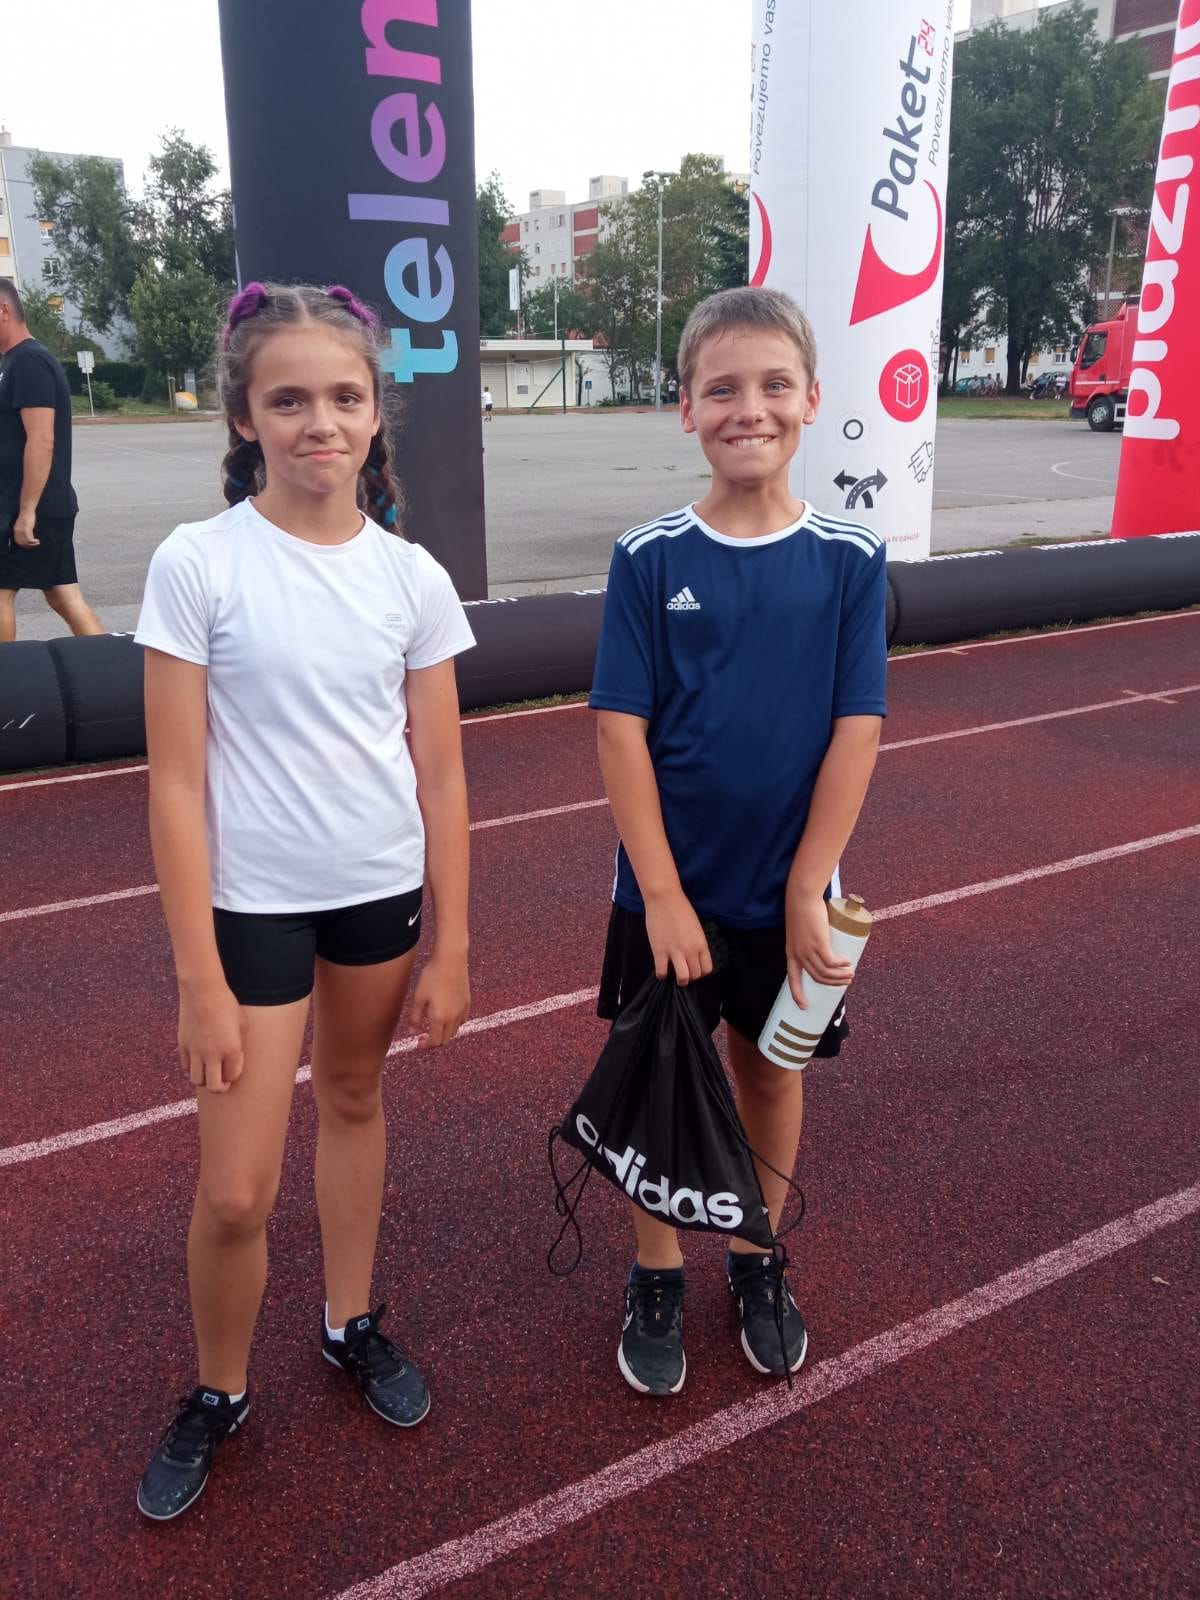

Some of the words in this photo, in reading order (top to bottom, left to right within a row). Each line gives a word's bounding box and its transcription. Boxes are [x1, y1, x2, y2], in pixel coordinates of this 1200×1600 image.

[752, 42, 772, 176] Povezujemo
[871, 34, 931, 222] Paket
[917, 18, 936, 57] 24
[928, 36, 951, 168] Povezujemo
[666, 601, 701, 611] adidas
